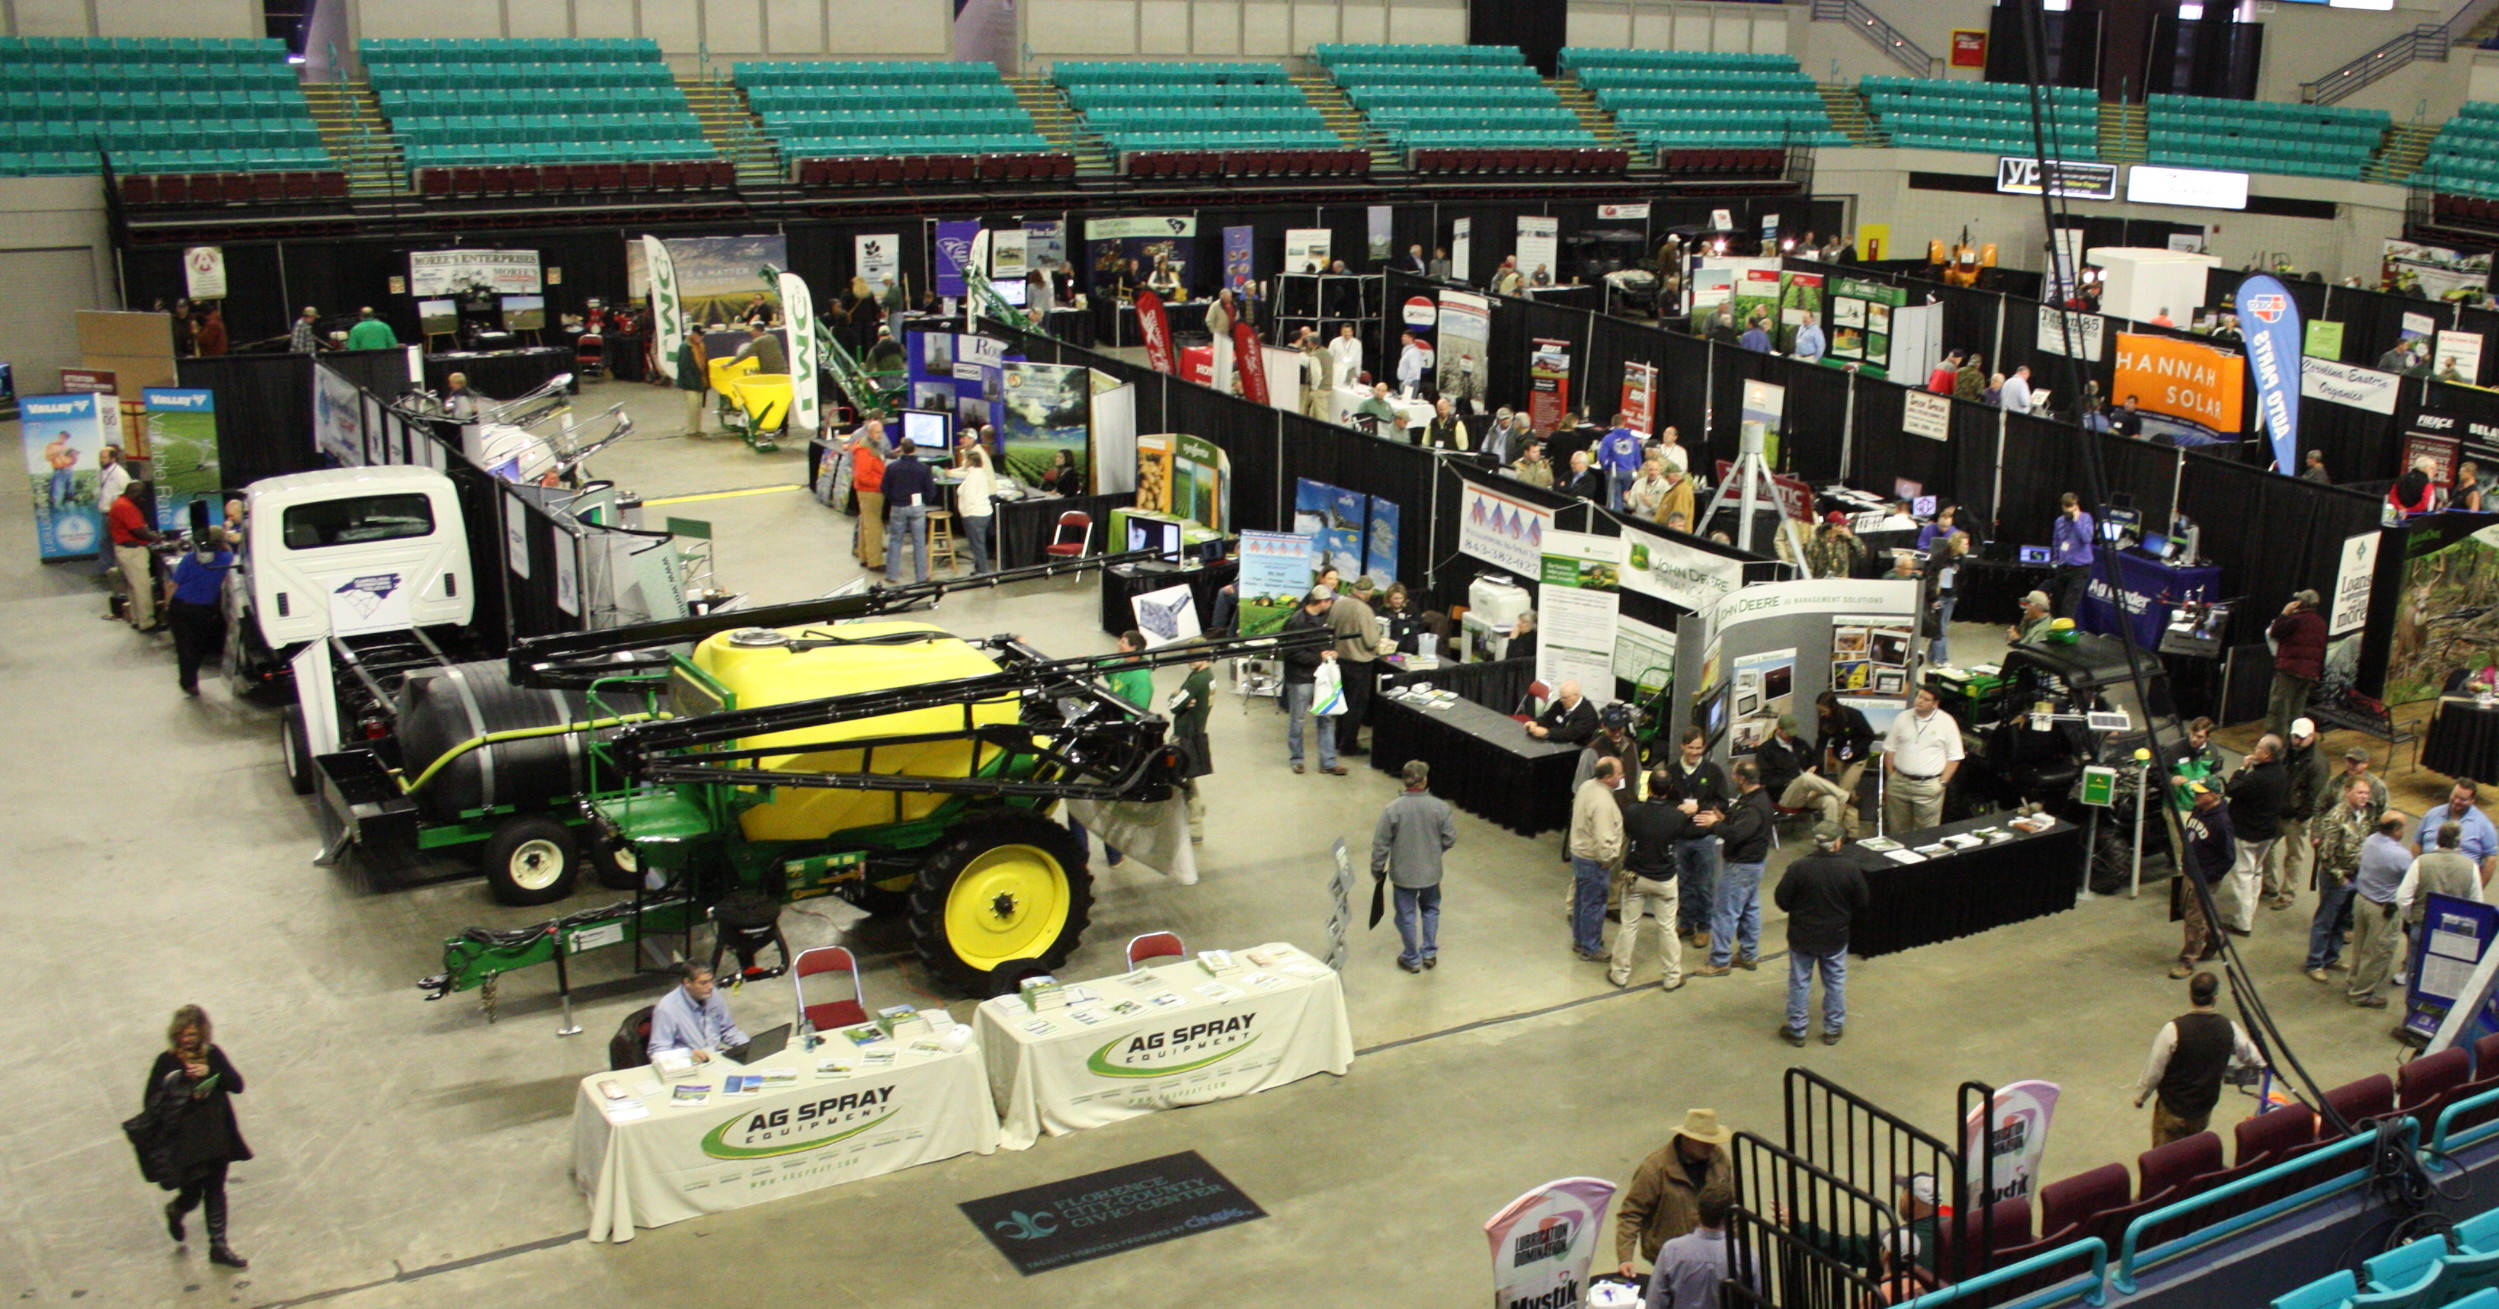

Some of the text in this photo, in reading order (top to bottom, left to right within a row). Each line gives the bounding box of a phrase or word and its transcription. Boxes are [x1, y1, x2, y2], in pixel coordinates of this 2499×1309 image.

[2008, 161, 2040, 186] yp
[2083, 317, 2099, 331] 85
[2116, 351, 2216, 389] HANNAH
[2302, 359, 2344, 381] Carolina
[2166, 386, 2222, 421] SOLAR
[2319, 381, 2363, 402] Organics
[2416, 414, 2455, 430] FIERCE
[157, 486, 173, 525] Rate
[1653, 557, 1687, 580] JOHN
[1739, 596, 1780, 612] DEERE
[1794, 596, 1841, 604] MANAGEMENT
[1125, 1032, 1250, 1064] EQUIPMENT
[1128, 1012, 1257, 1054] AG SPRAY
[745, 1105, 887, 1144] EQUIPMENT
[747, 1085, 896, 1133] AG SPRAY
[1054, 1176, 1168, 1210] FLORENCE
[1071, 1184, 1226, 1228] CIVIC CENTER
